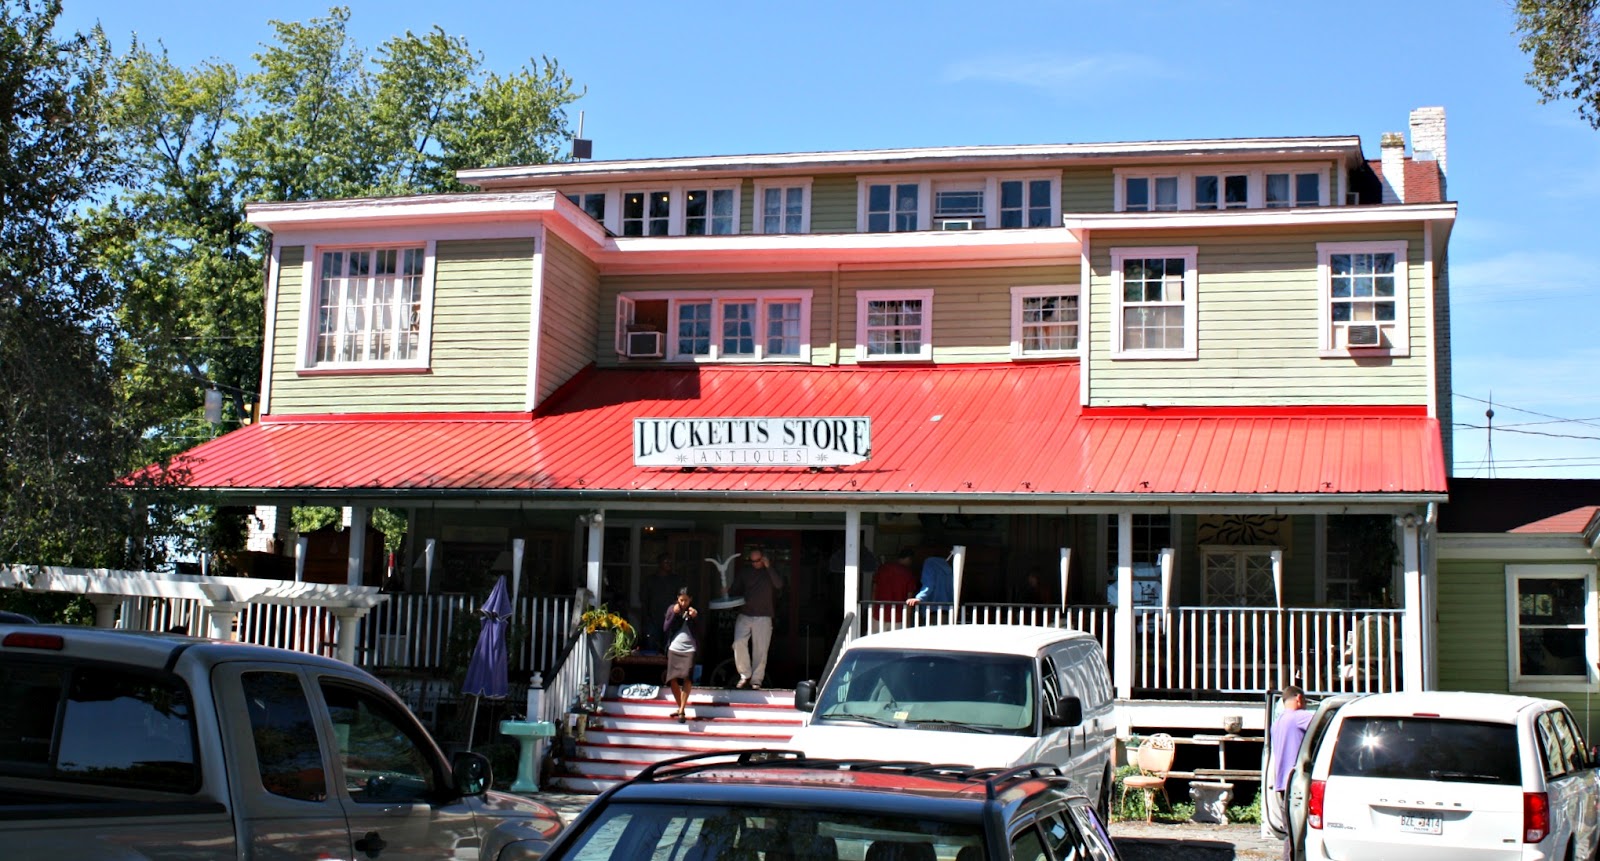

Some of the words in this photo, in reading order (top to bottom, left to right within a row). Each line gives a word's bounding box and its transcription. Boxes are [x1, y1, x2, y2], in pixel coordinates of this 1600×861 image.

[637, 420, 769, 458] LUCKETTS
[783, 419, 869, 457] STORE
[701, 451, 802, 464] ANTIQUES
[621, 687, 654, 697] OPEN
[1379, 798, 1462, 807] DODGE
